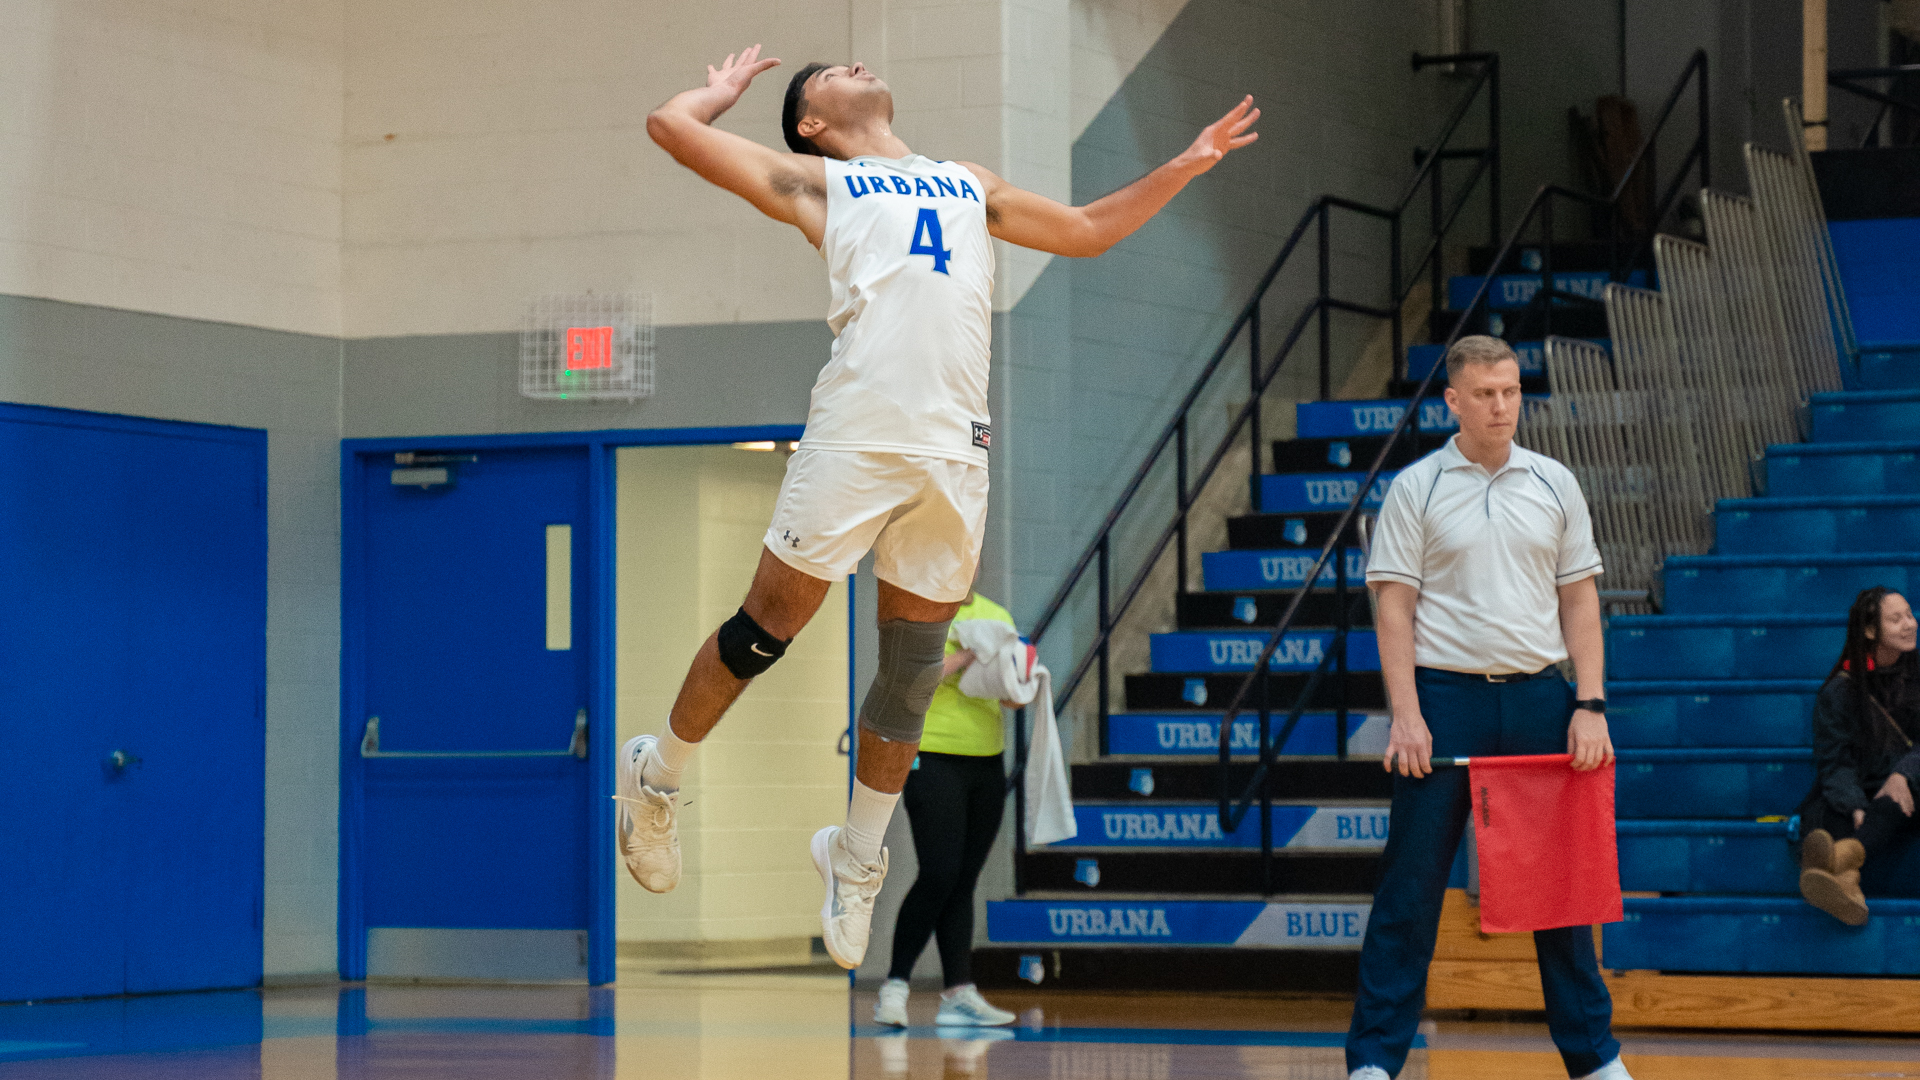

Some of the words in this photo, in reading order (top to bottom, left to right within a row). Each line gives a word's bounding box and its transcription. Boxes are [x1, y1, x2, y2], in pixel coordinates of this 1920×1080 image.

[844, 175, 981, 204] URBANA
[907, 206, 952, 277] 4
[1502, 279, 1605, 301] URNA
[1353, 405, 1460, 430] URBNA
[1157, 722, 1274, 748] URBN
[1102, 813, 1224, 839] URBANA
[1336, 815, 1389, 840] BLU
[1047, 909, 1171, 936] URBANA
[1286, 912, 1361, 938] BLUE
